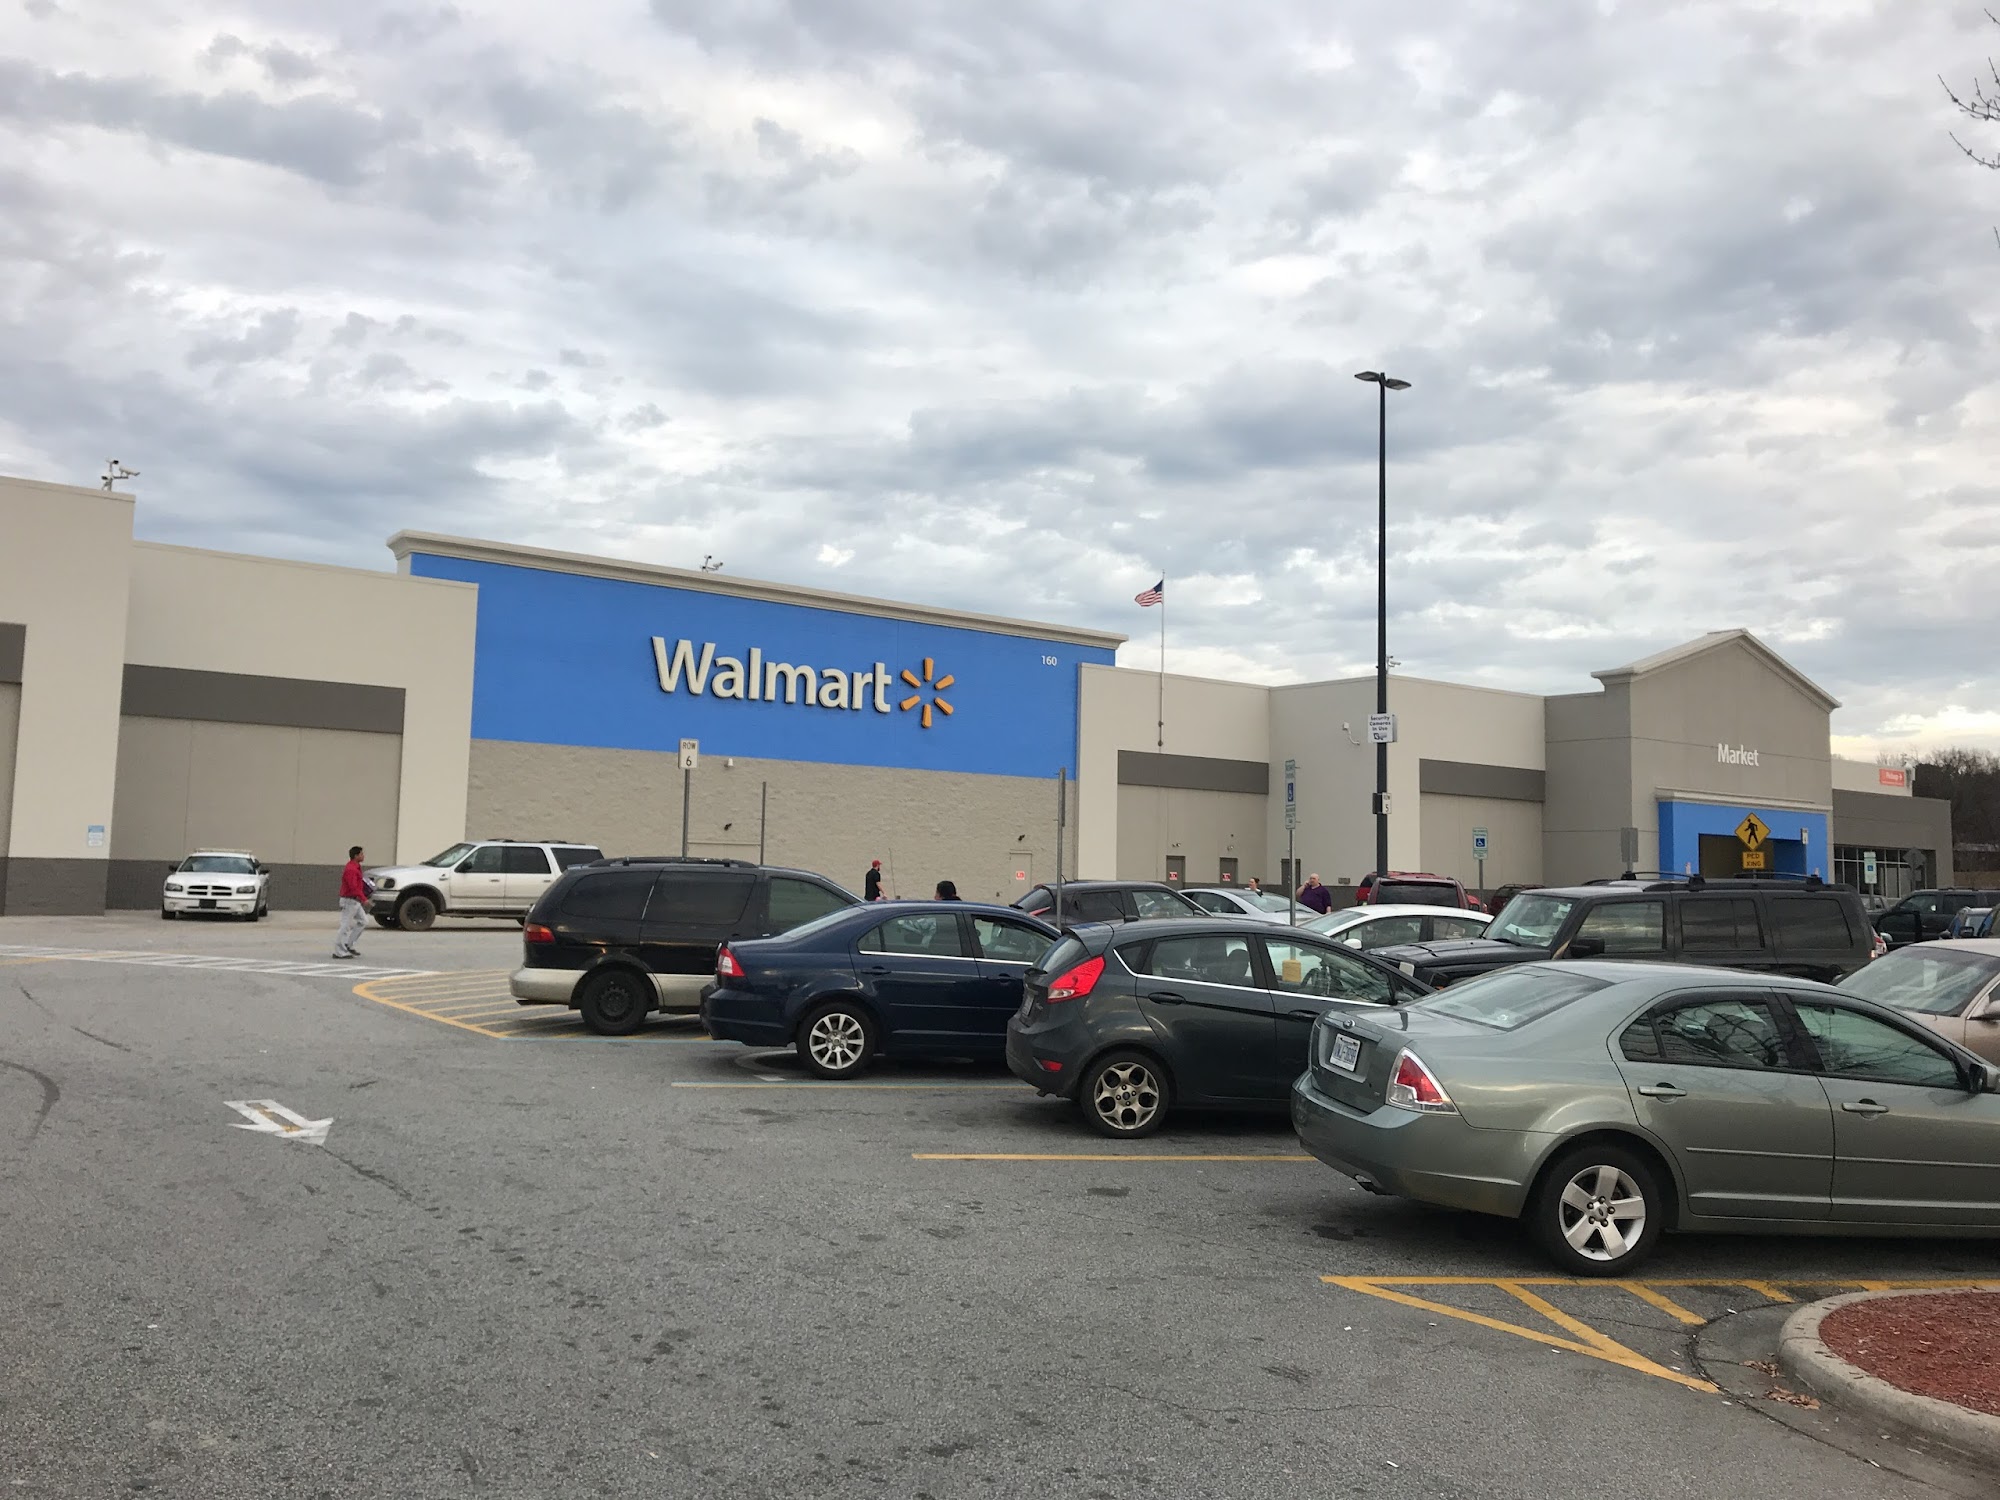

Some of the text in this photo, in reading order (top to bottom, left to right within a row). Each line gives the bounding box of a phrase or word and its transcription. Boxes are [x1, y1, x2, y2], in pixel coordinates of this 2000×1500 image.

[1041, 655, 1058, 667] 160
[652, 636, 891, 713] Walmart
[682, 741, 697, 750] ROW
[686, 755, 692, 767] 6
[1717, 743, 1760, 767] Market
[1385, 803, 1390, 813] 5
